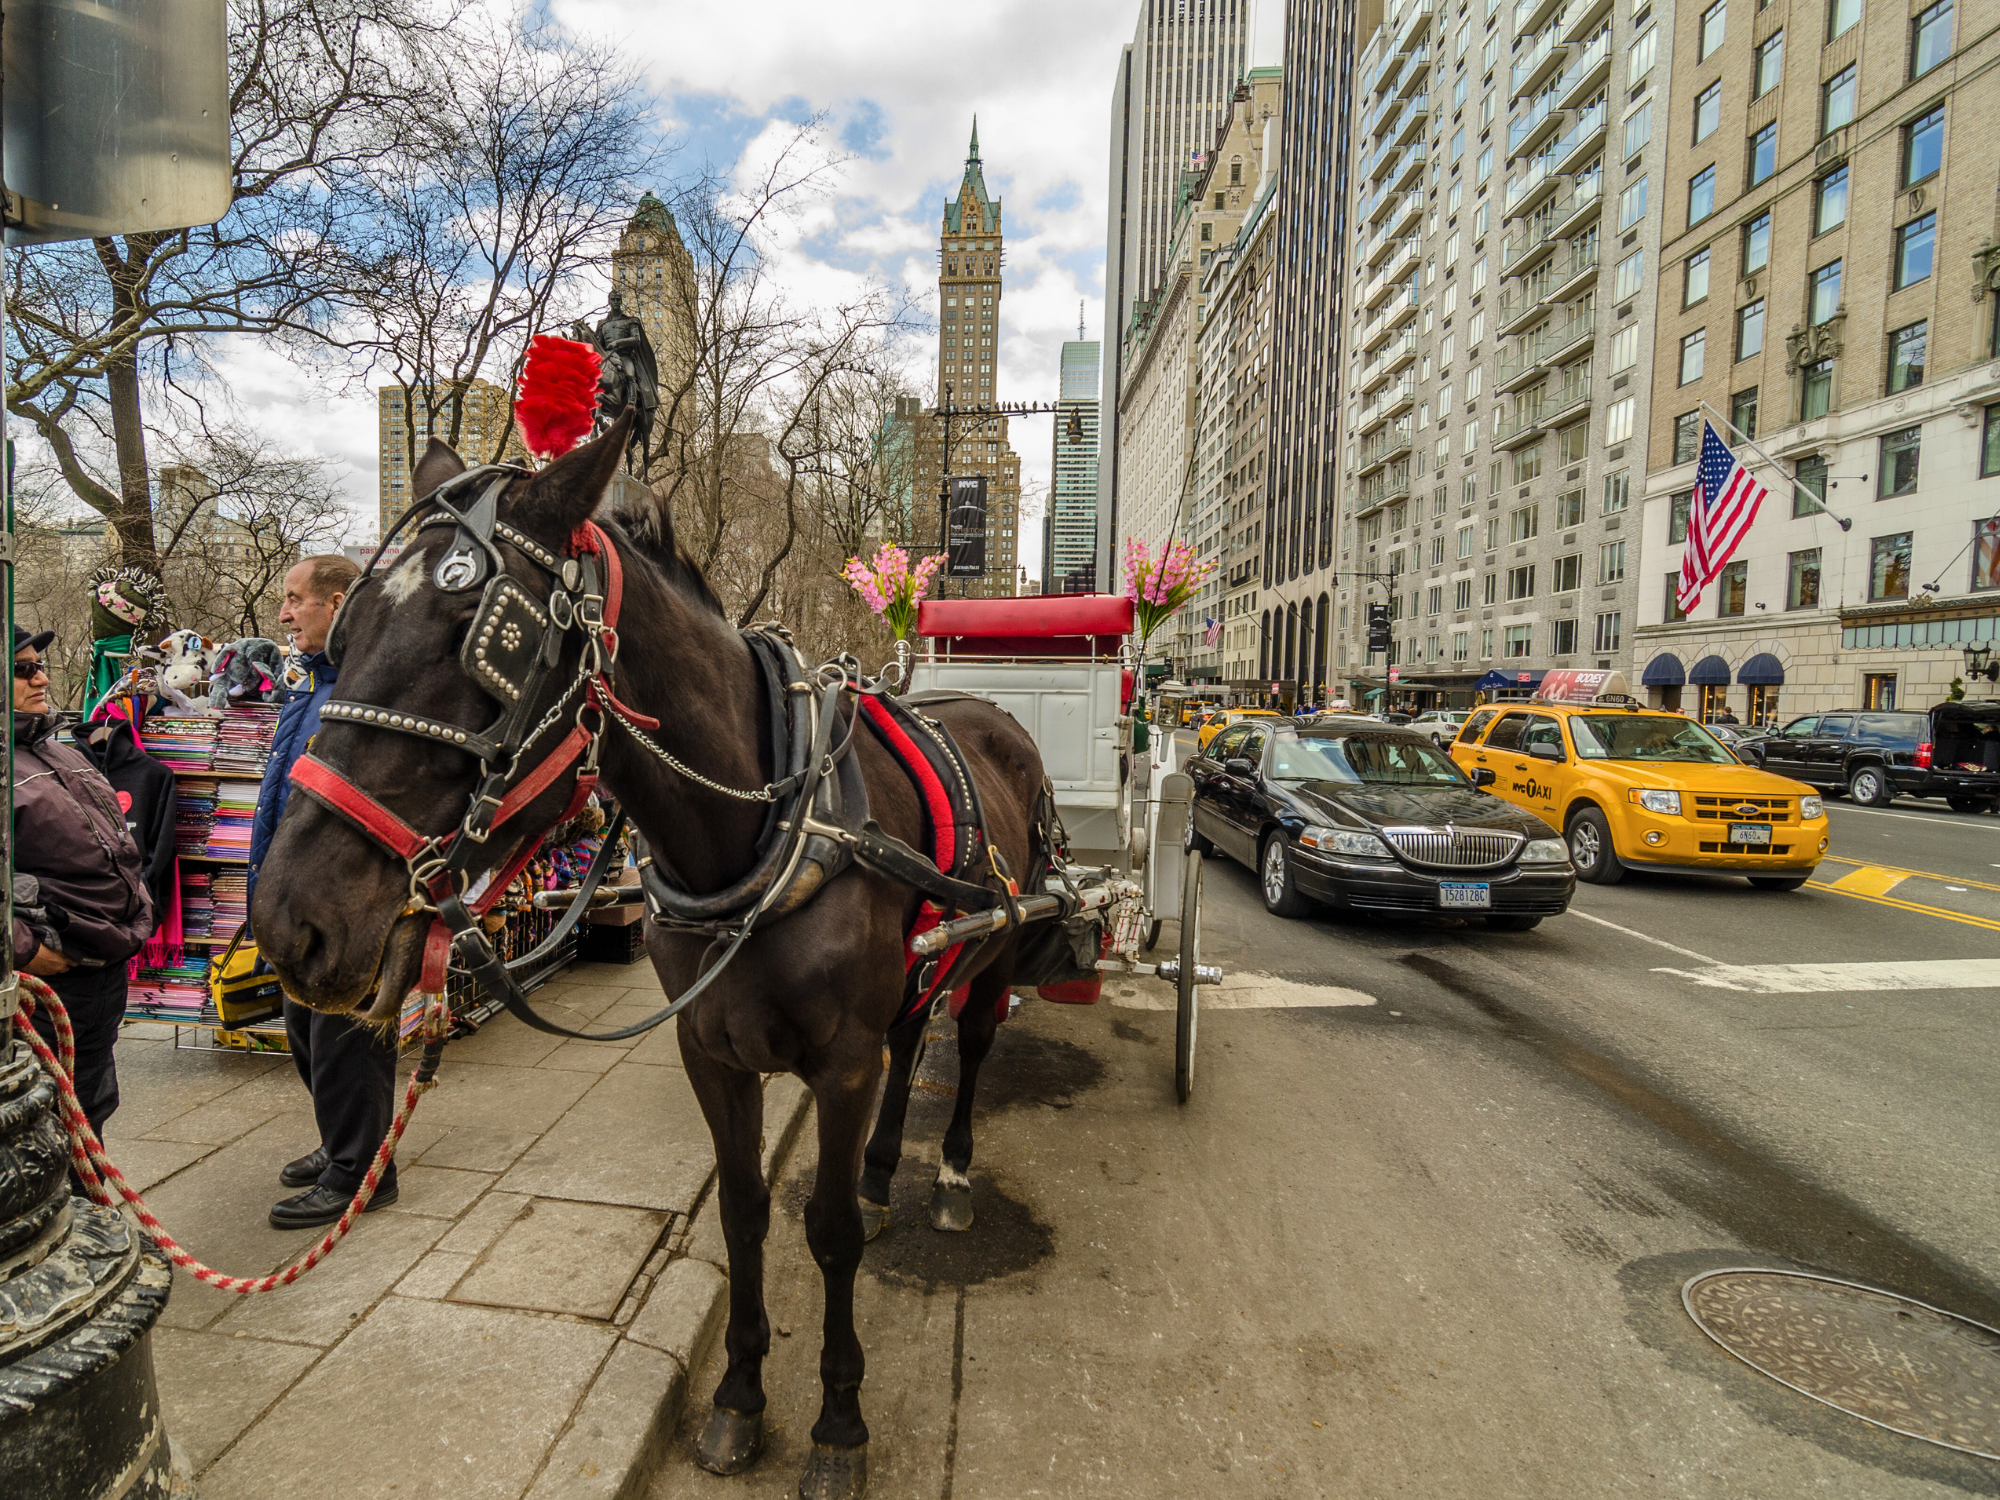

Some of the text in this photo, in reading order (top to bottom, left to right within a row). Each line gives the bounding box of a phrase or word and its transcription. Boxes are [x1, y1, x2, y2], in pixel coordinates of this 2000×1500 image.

[958, 480, 978, 488] NYC
[1574, 673, 1605, 683] BODIES
[1605, 694, 1625, 703] 6N60
[1512, 782, 1526, 793] NYC
[1526, 778, 1552, 800] TAXI
[1445, 889, 1485, 902] T528128C
